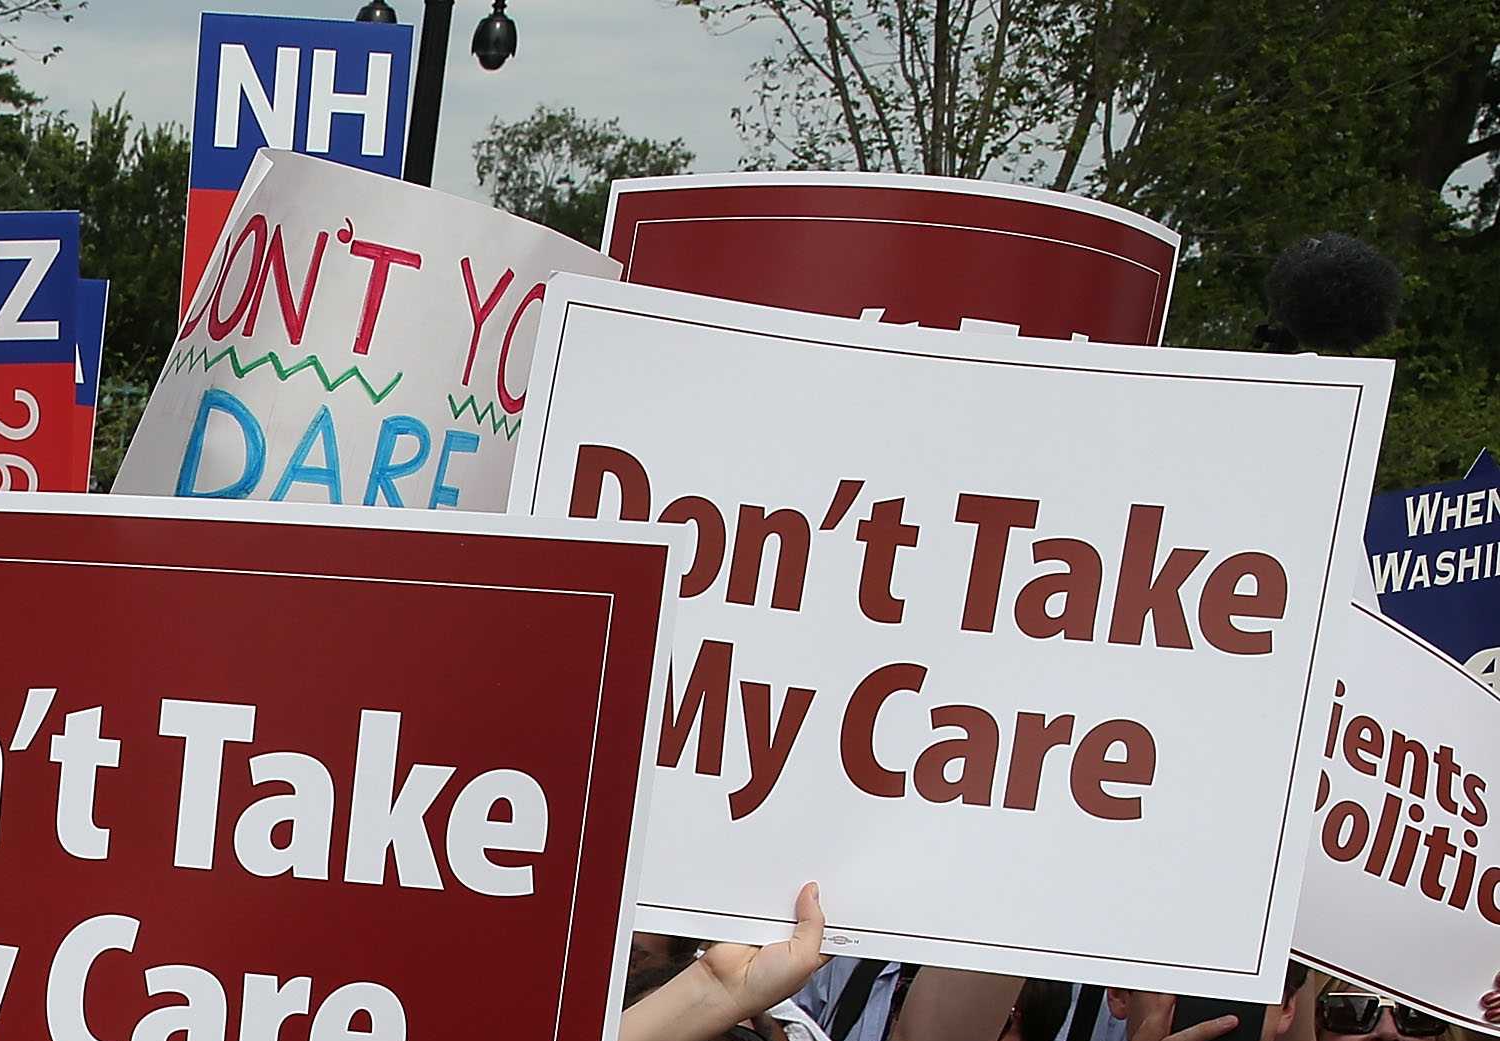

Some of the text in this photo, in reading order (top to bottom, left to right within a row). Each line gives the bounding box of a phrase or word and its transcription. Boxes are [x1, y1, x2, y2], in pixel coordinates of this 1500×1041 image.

[213, 43, 392, 157] NH
[174, 388, 481, 509] DARE
[568, 443, 1289, 656] Don't Take
[1371, 540, 1500, 595] WASHI
[158, 697, 550, 898] Take
[656, 638, 1157, 822] My Care
[1314, 768, 1500, 926] olitic
